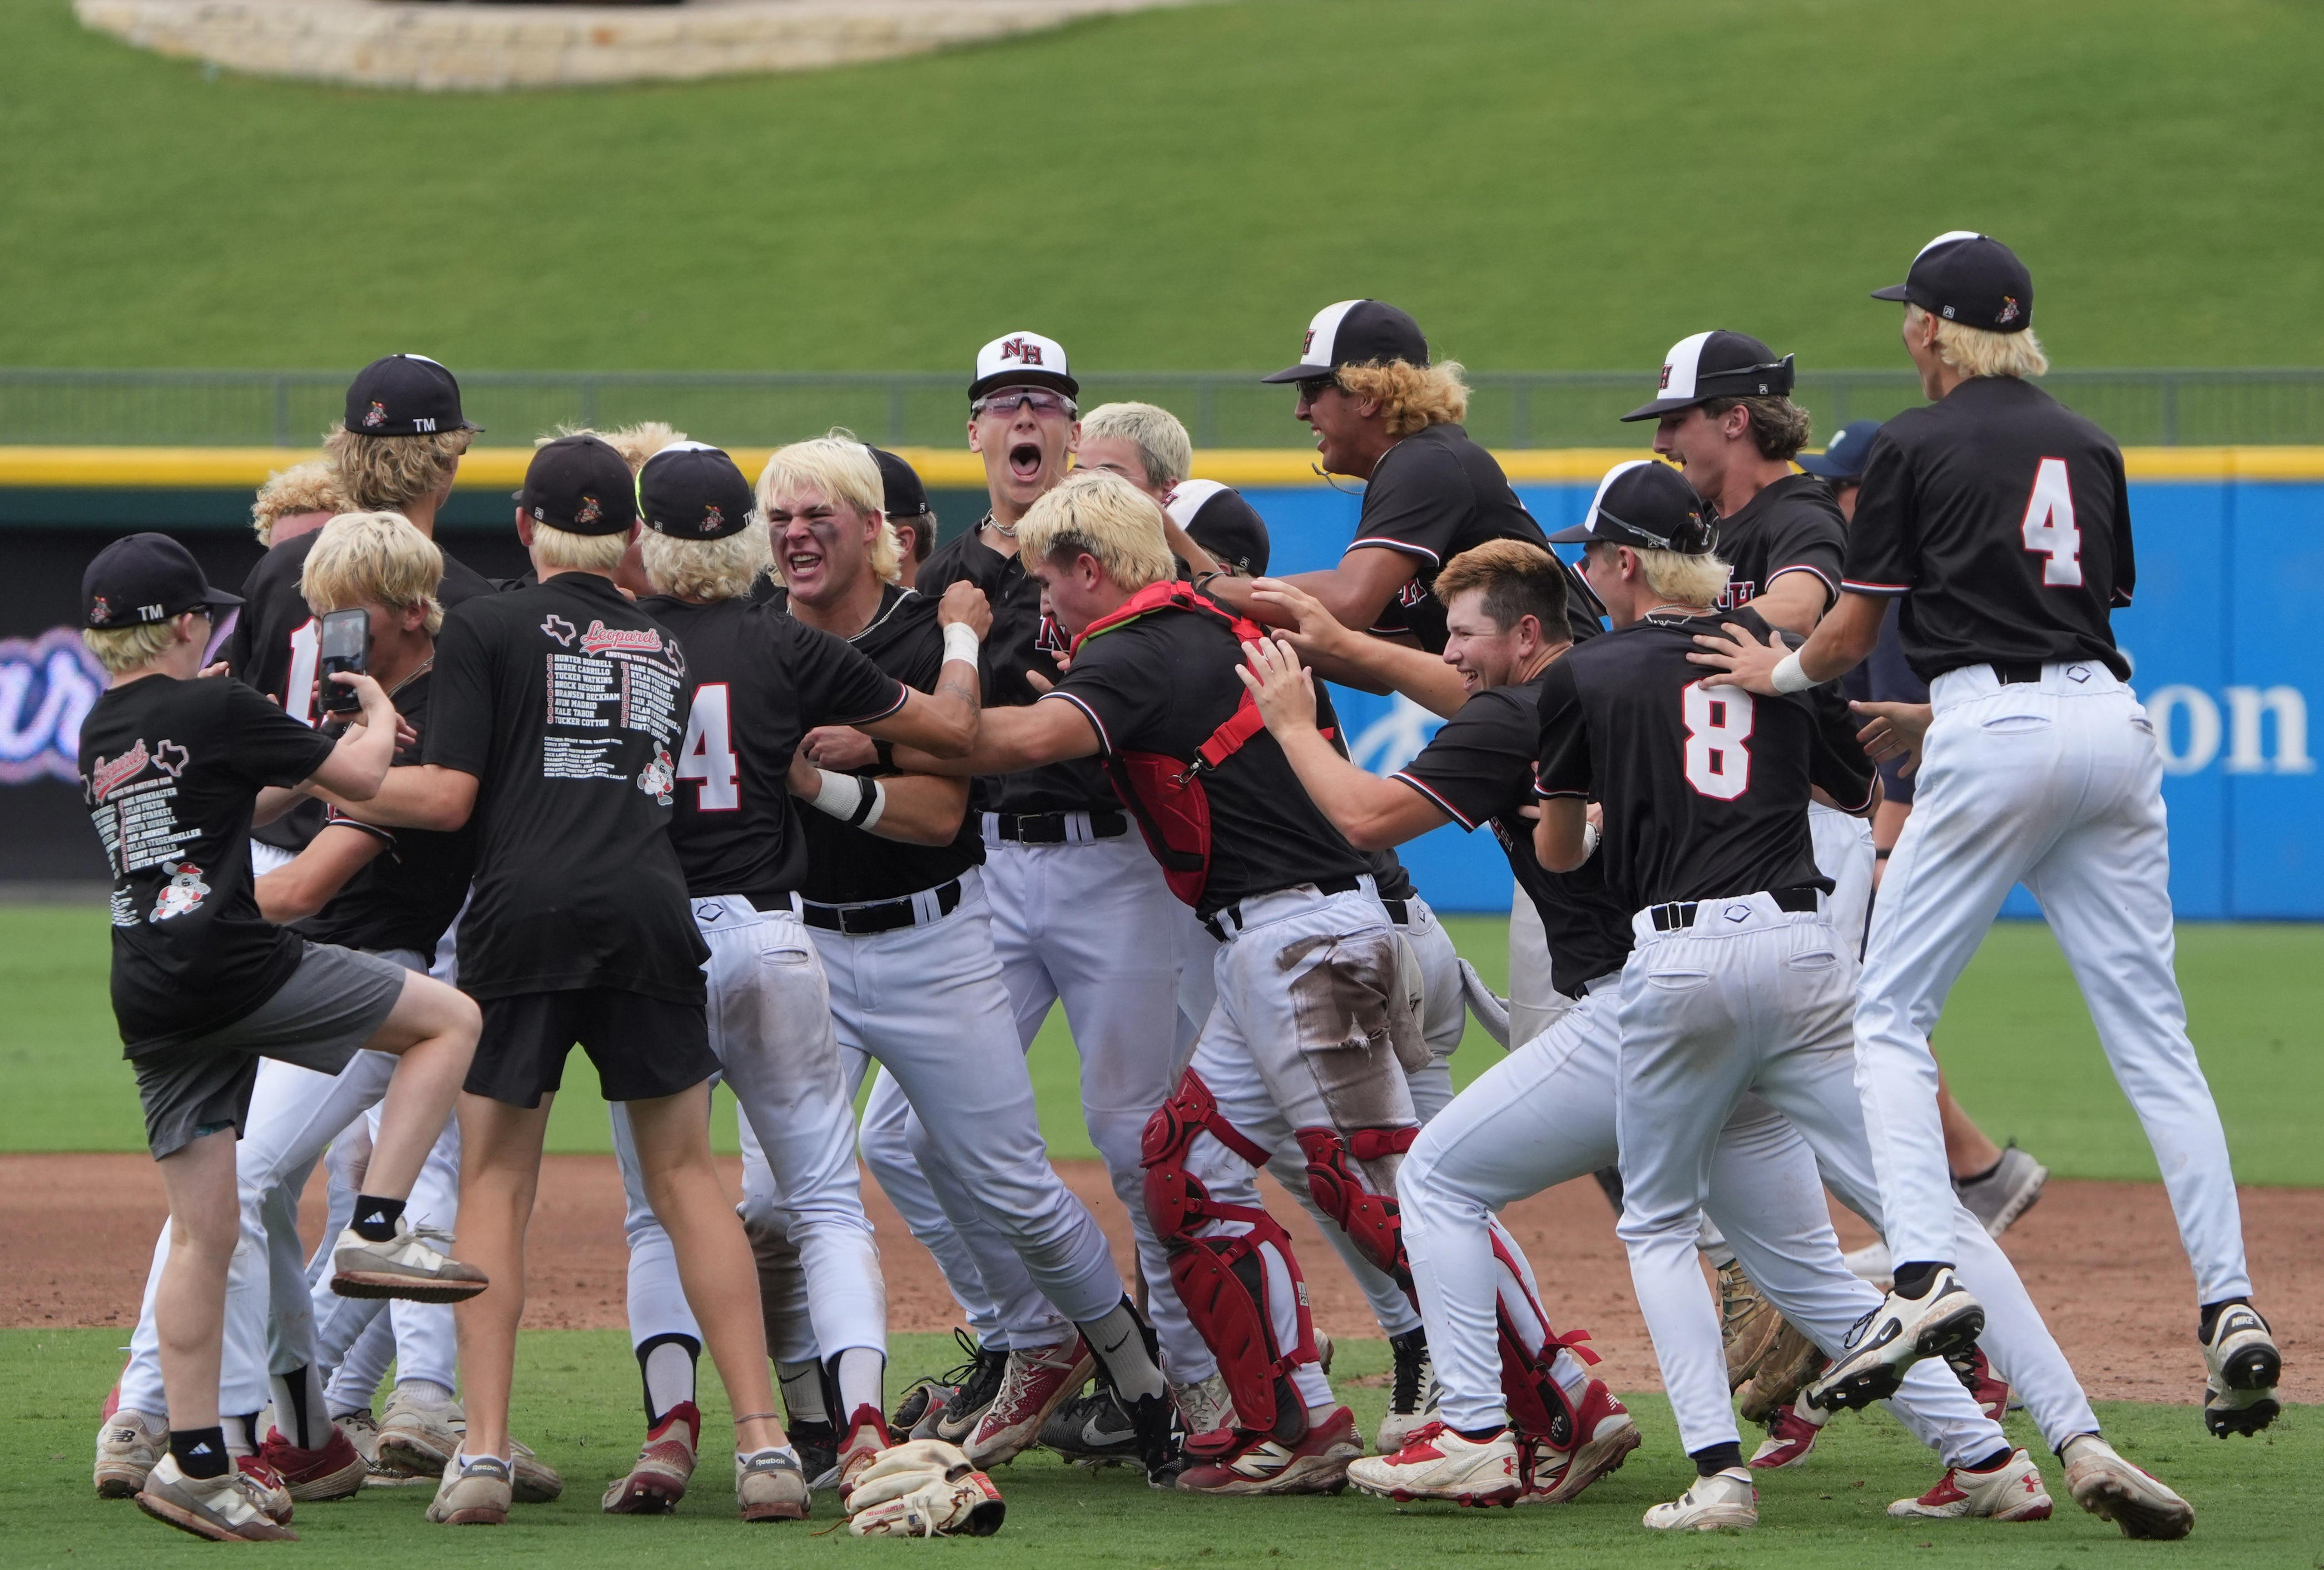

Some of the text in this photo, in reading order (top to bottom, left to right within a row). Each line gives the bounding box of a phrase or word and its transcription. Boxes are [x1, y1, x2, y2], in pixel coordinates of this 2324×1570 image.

[1000, 336, 1044, 366] NH
[413, 418, 436, 432] TM
[2020, 456, 2084, 587] 4
[137, 603, 163, 622] TM
[579, 620, 662, 648] Leopards
[554, 654, 581, 664] HUNTER
[582, 658, 613, 667] BURRELL
[554, 663, 577, 672] DEREK
[578, 665, 610, 676] CARRILLO
[605, 651, 632, 660] ANOTHER
[632, 655, 647, 663] YEAR
[648, 658, 668, 672] ANOTHER
[284, 616, 329, 730] 1
[554, 672, 581, 681] TUCKER
[582, 675, 613, 684] WATKINS
[630, 663, 646, 672] GABE
[647, 667, 680, 689] BURKHALTER
[631, 671, 651, 683] KYLAN
[651, 677, 671, 692] FULTON
[554, 681, 576, 689] BROCK
[578, 683, 605, 692] BESSIRE
[554, 689, 584, 700] BRANSEN
[631, 678, 650, 690] RYDER
[651, 685, 674, 702] STARKEY
[555, 698, 569, 707] AVIN
[571, 700, 597, 710] MADRID
[631, 687, 652, 700] AUSTIN
[652, 694, 675, 711] BURRELL
[631, 696, 645, 706] JAIR
[646, 700, 668, 716] JOHNSON
[555, 707, 572, 716] KALE
[573, 709, 594, 718] TABOR
[630, 704, 651, 715] RYLAN
[630, 712, 651, 723] KENNY
[2118, 646, 2318, 776] on
[554, 716, 580, 725] TUCKER
[651, 727, 671, 745] SIMPSON
[1682, 677, 1756, 801] 8
[676, 682, 741, 812] 4
[142, 807, 172, 820] STARKEY
[146, 828, 202, 847] STEGEMOELLER
[155, 849, 186, 864] SIMPSON
[2232, 1316, 2253, 1328] NIKE
[756, 1458, 785, 1467] Reebok
